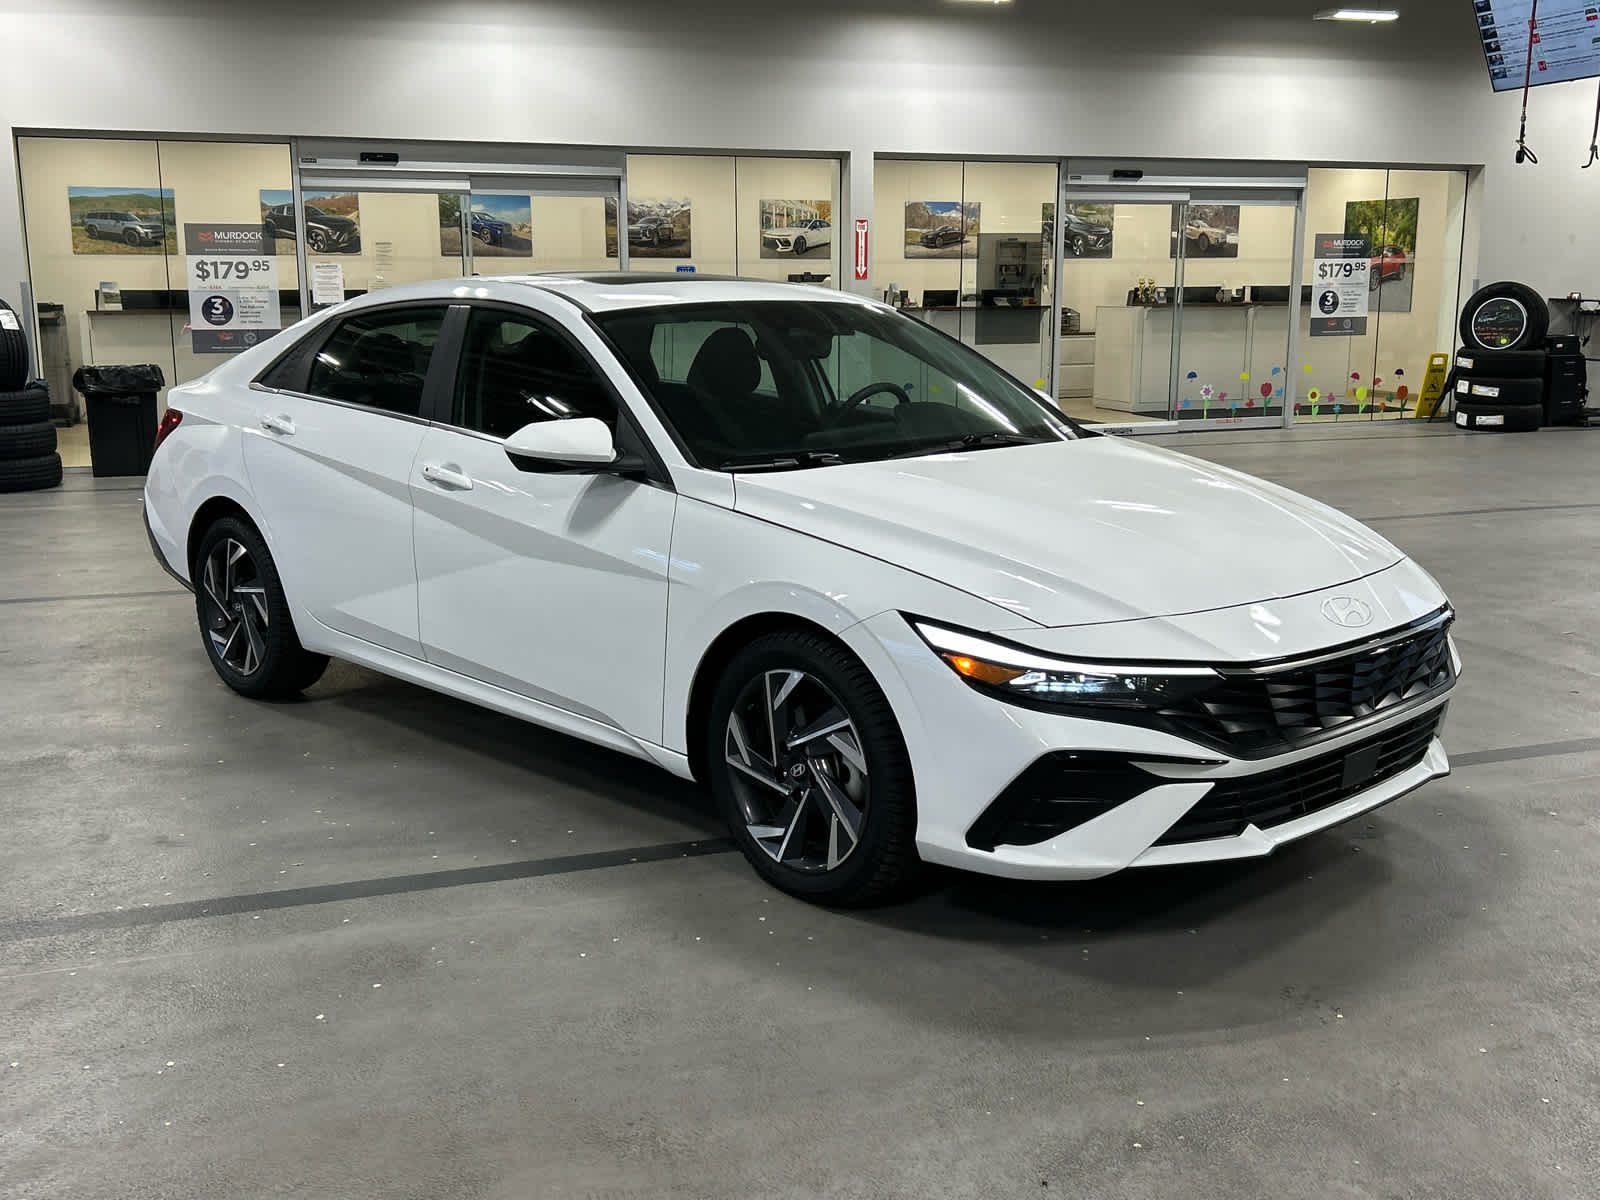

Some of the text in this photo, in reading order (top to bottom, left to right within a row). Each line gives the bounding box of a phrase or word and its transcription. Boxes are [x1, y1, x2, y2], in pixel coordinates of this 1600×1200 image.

[214, 231, 263, 240] MURDOCK
[195, 259, 270, 282] $179.95
[1318, 262, 1366, 280] $179.95
[210, 298, 224, 314] 3
[1325, 292, 1334, 306] 3
